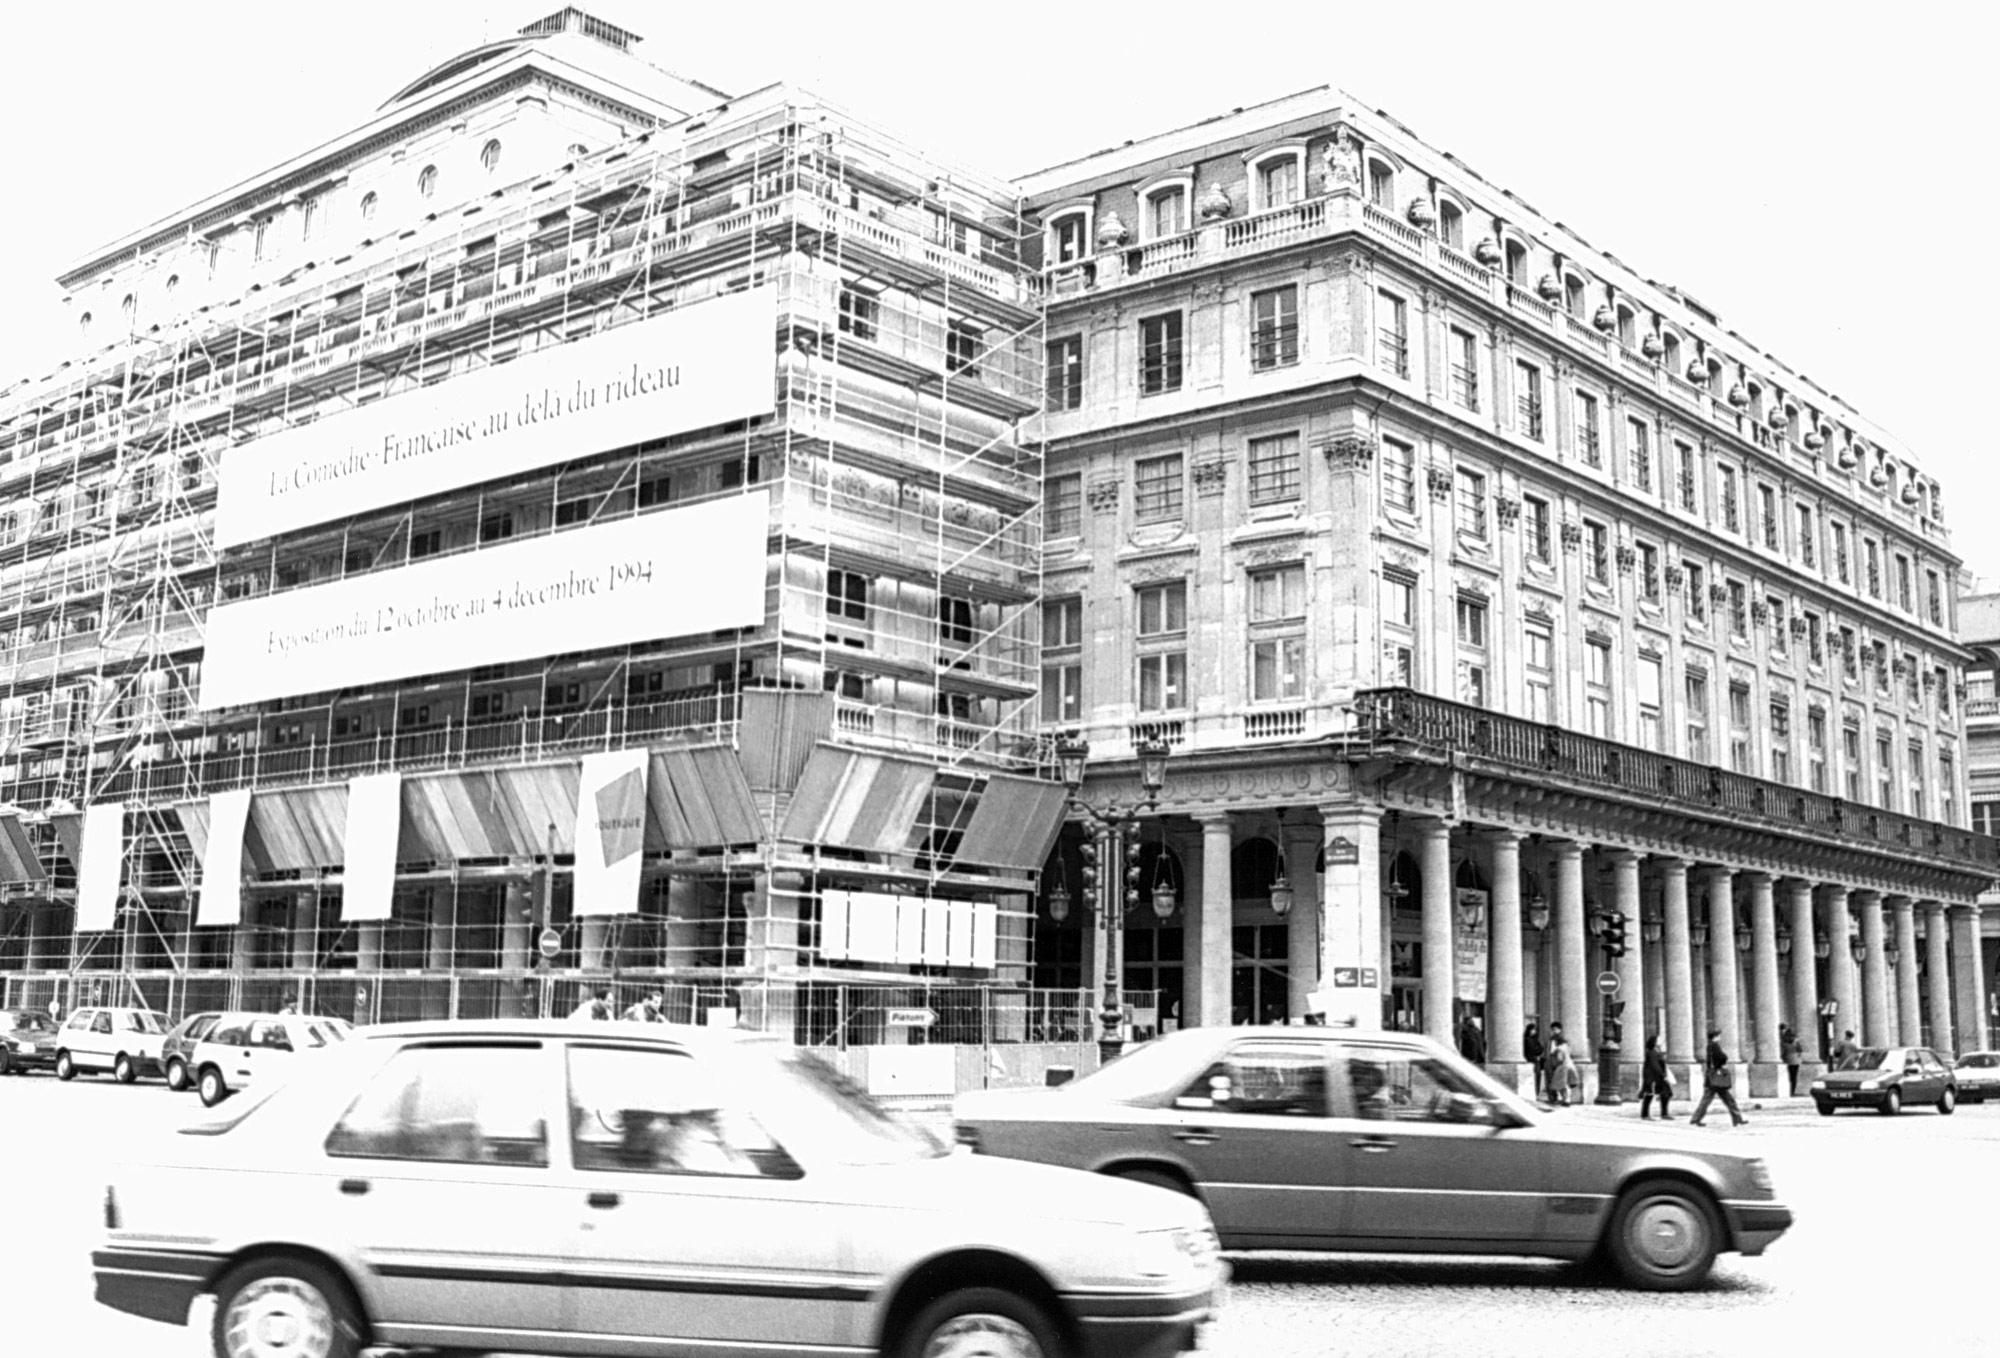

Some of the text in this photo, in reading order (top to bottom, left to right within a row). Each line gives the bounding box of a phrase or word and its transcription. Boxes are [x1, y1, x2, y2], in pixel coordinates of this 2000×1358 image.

[483, 412, 508, 437] au
[568, 379, 595, 413] du
[605, 363, 680, 403] rideau
[349, 611, 368, 637] du
[376, 606, 394, 633] 12
[397, 596, 460, 628] octobre
[465, 599, 485, 617] au
[492, 590, 502, 611] 4
[609, 560, 652, 591] 1994
